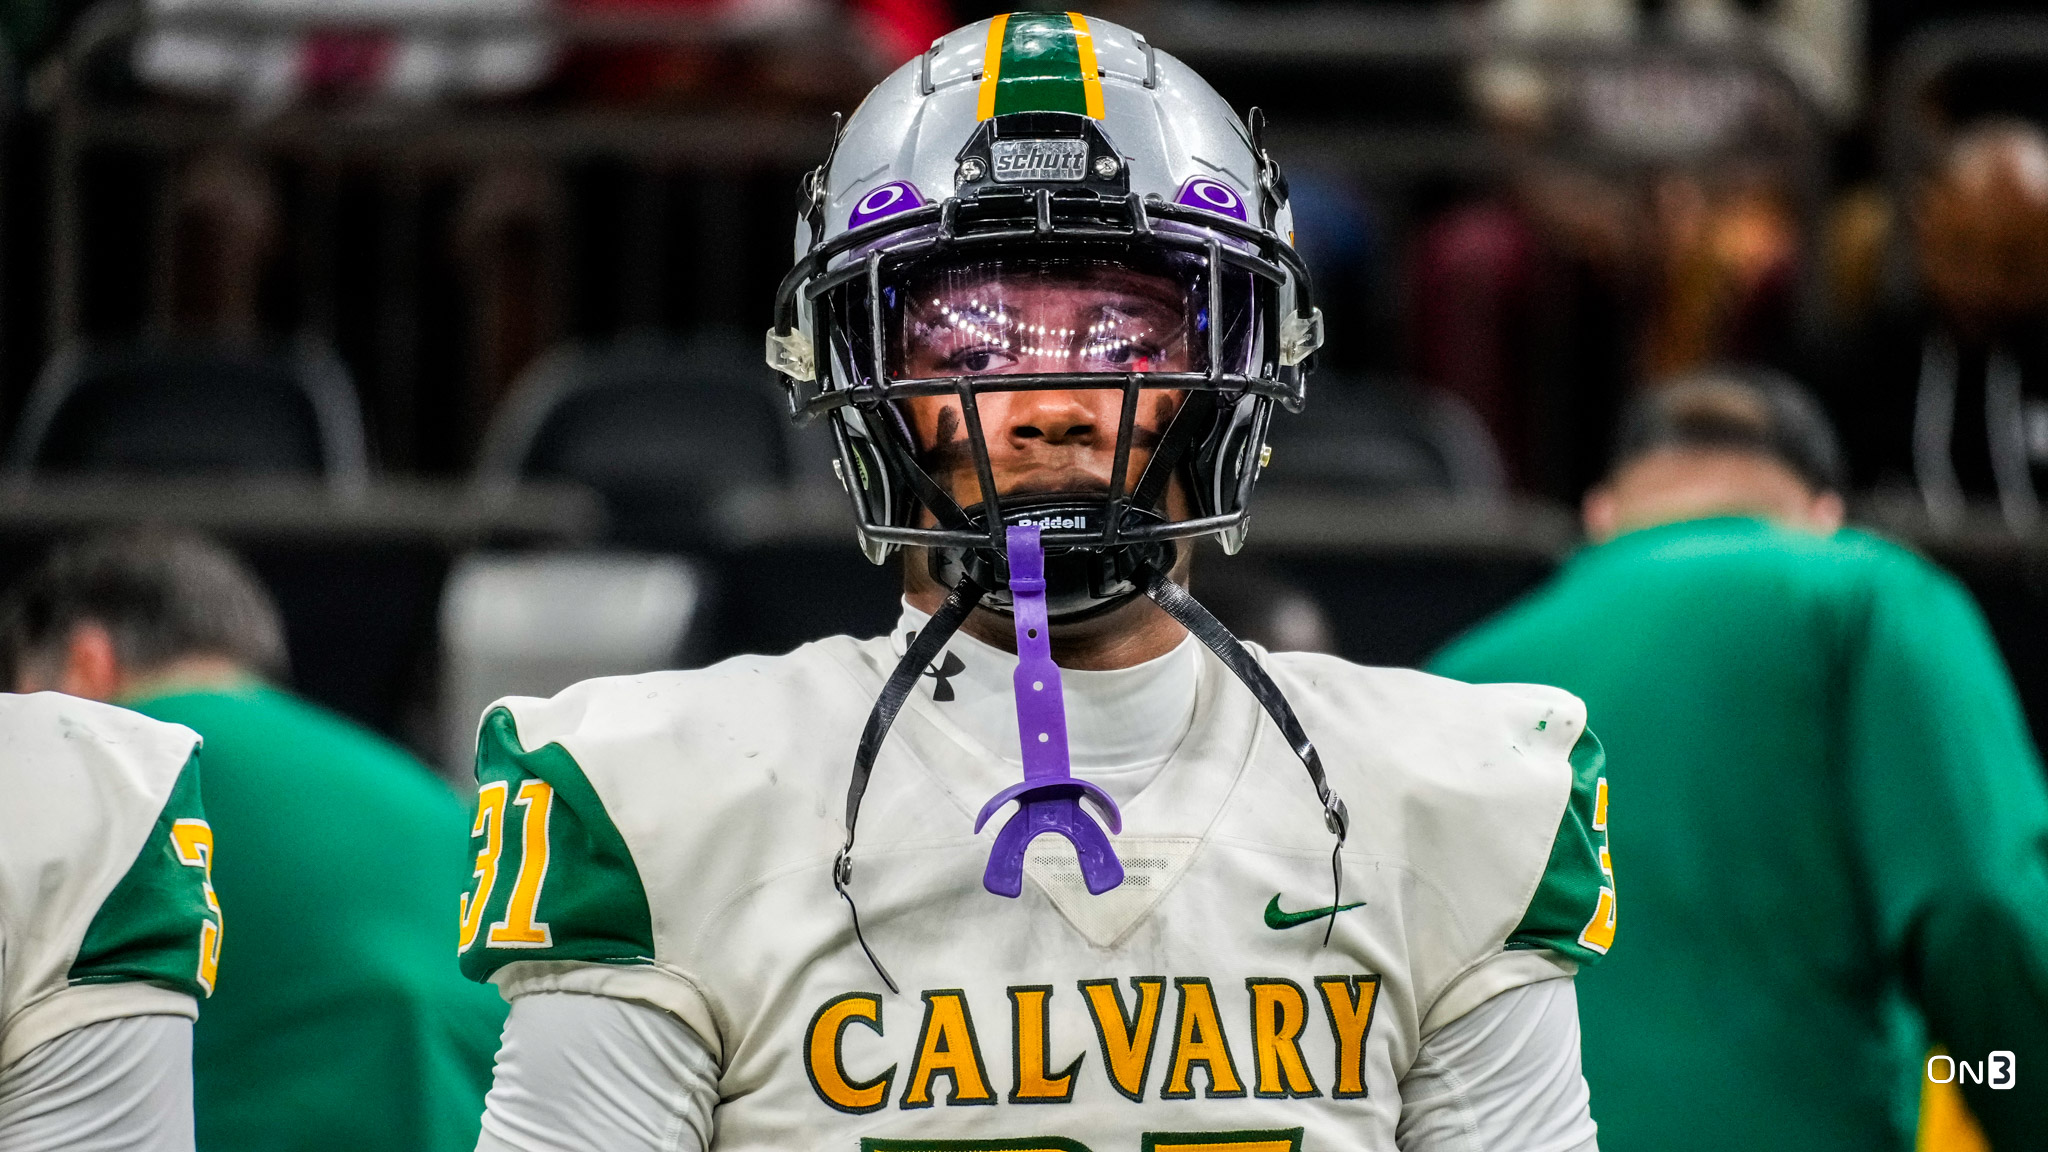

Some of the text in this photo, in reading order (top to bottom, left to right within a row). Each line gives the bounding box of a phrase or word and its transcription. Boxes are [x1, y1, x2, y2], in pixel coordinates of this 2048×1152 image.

[996, 148, 1085, 171] schutt
[458, 778, 554, 957] 31
[803, 974, 1382, 1115] CALVARY
